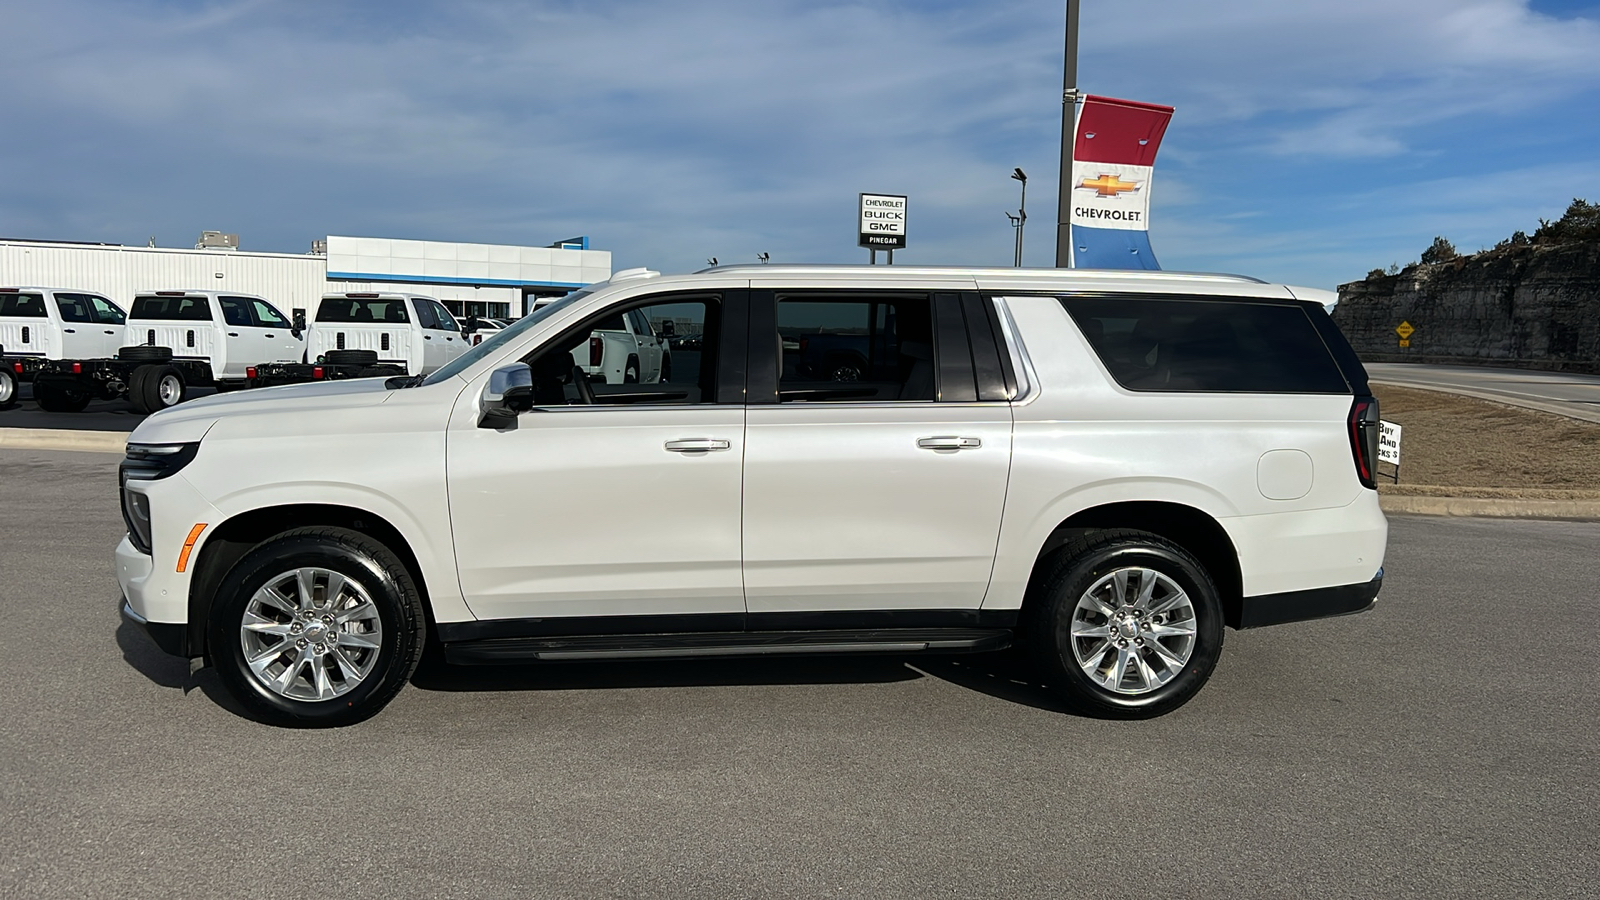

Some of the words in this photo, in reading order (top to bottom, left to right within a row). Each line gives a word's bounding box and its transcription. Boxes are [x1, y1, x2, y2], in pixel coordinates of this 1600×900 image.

[865, 199, 903, 208] CHEVROLET
[864, 210, 903, 220] BUICK
[869, 222, 898, 232] GMC
[869, 236, 898, 245] PINEGAR
